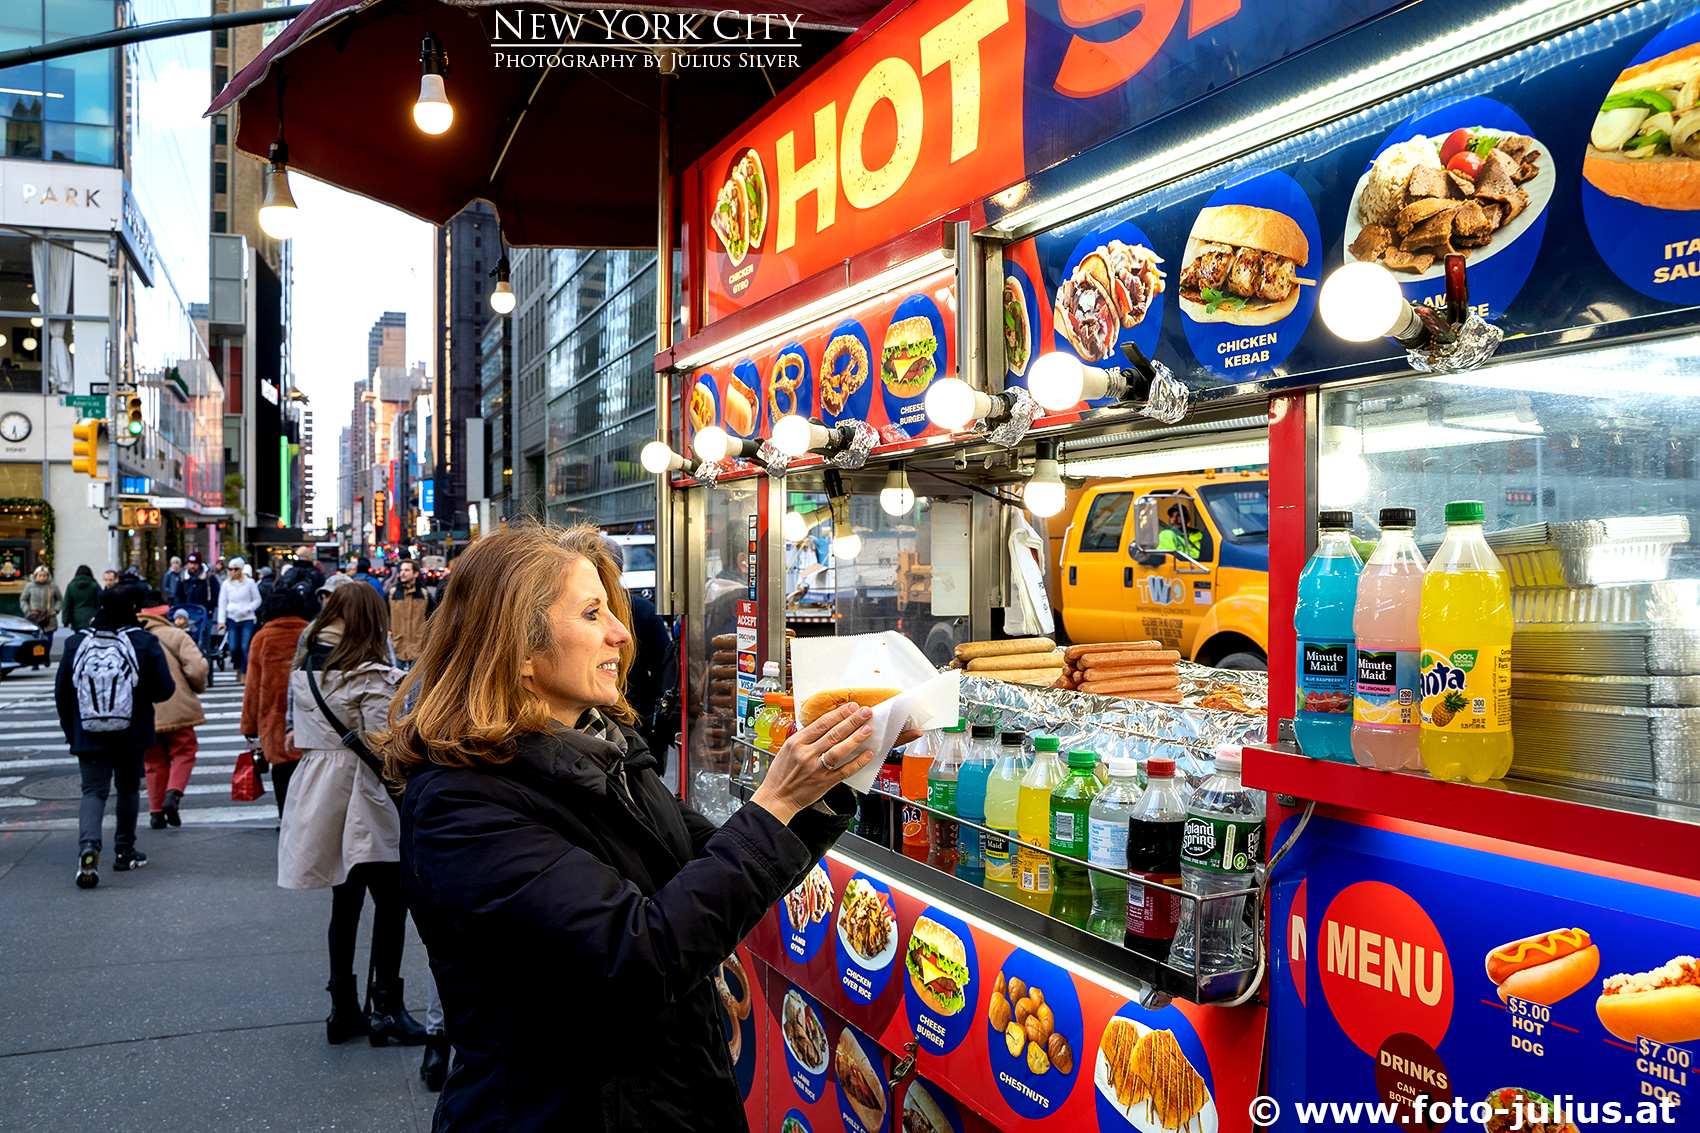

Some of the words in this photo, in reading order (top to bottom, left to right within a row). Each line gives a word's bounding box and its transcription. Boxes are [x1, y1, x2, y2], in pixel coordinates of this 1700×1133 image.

[775, 0, 1010, 254] HOT
[23, 184, 101, 208] PARK
[1664, 238, 1700, 261] ITA
[728, 263, 754, 285] CHICKEN
[1653, 261, 1700, 285] SAU
[732, 278, 749, 294] GYRO
[1216, 332, 1278, 355] CHICKEN
[1224, 350, 1271, 369] KEBAB
[899, 413, 926, 426] BURGER
[900, 402, 925, 415] CHEESE
[1136, 574, 1187, 606] TWO
[742, 603, 752, 613] WE
[737, 615, 757, 627] ACCEPT
[1306, 651, 1344, 662] Minute
[1310, 661, 1338, 671] Maid
[1358, 658, 1392, 670] Minute
[740, 680, 754, 689] VISA
[1361, 669, 1386, 681] Maid
[1473, 699, 1485, 707] 300
[902, 804, 922, 824] nta
[1183, 822, 1214, 836] Poland
[987, 840, 1003, 850] Maid
[790, 942, 805, 956] GYRO
[791, 933, 806, 947] LAMB
[1327, 920, 1443, 1007] MENU
[842, 976, 859, 992] OVER
[858, 985, 872, 1001] RICE
[846, 967, 872, 989] CHICKEN
[1509, 997, 1550, 1023] $5.00
[916, 1024, 945, 1049] BURGER
[919, 1014, 946, 1037] CHEESE
[1512, 1015, 1544, 1037] HOT
[1511, 1035, 1544, 1057] DOG
[1639, 1038, 1690, 1068] $7.00
[1380, 1049, 1448, 1090] DRINKS
[1636, 1058, 1687, 1087] CHILI
[999, 1071, 1050, 1109] CHESTNUTS
[1396, 1081, 1416, 1096] CAN
[1641, 1080, 1681, 1107] DOG
[1389, 1090, 1423, 1113] BOTT
